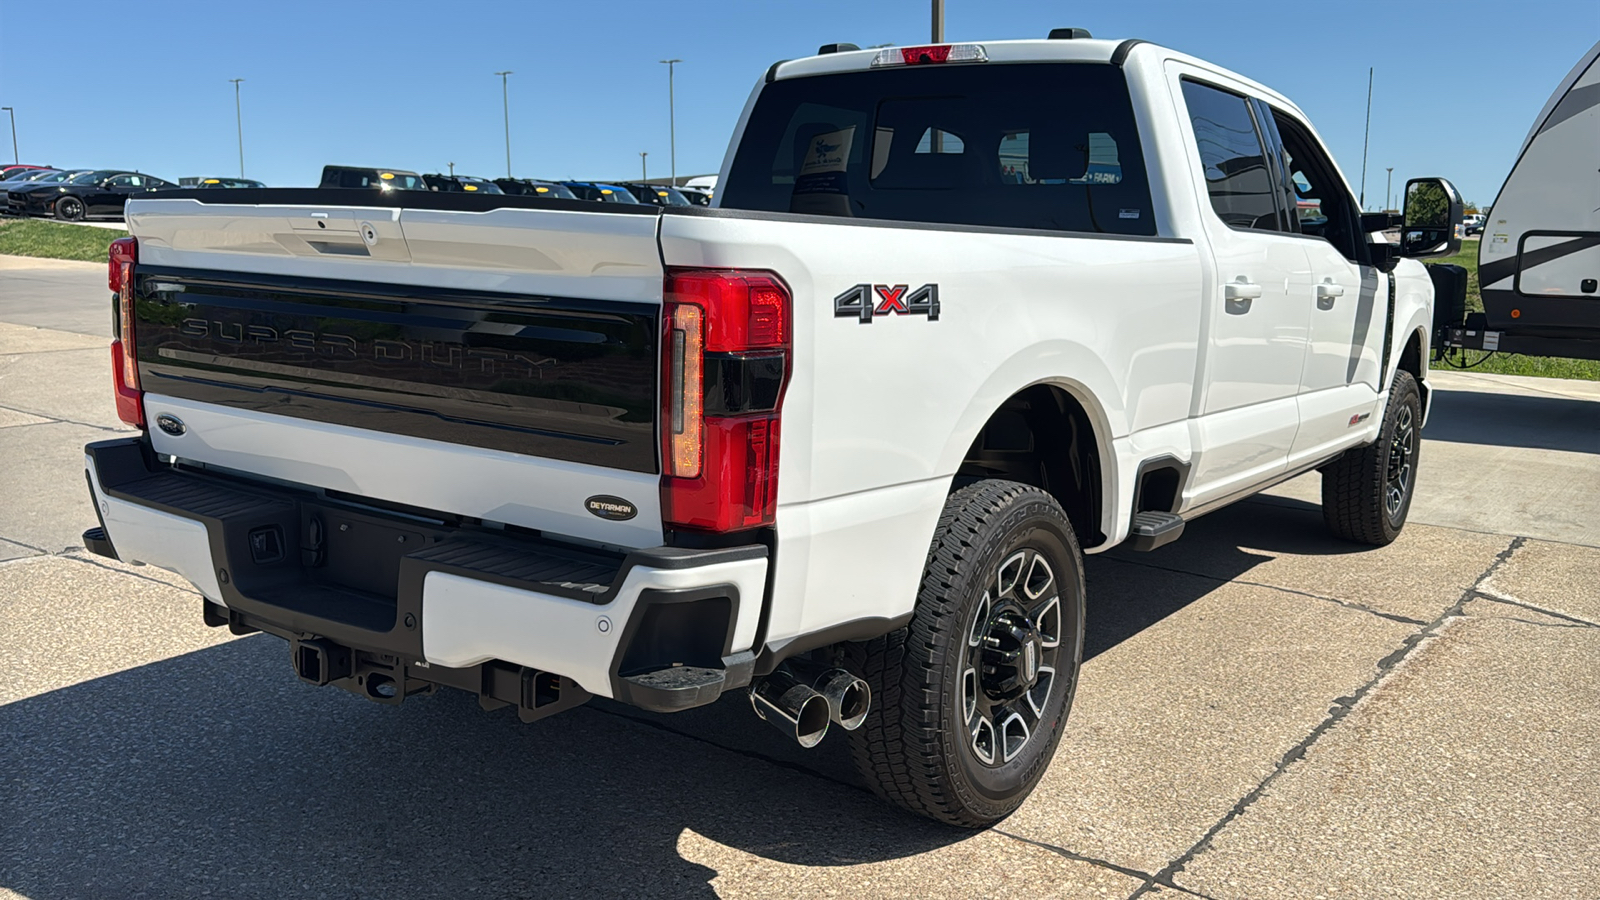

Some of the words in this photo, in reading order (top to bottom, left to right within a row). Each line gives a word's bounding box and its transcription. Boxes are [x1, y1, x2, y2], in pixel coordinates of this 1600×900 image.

[1094, 172, 1116, 184] FARM
[182, 317, 357, 357] SUPER
[374, 338, 557, 379] DUTY
[590, 501, 632, 513] DEYARMAN
